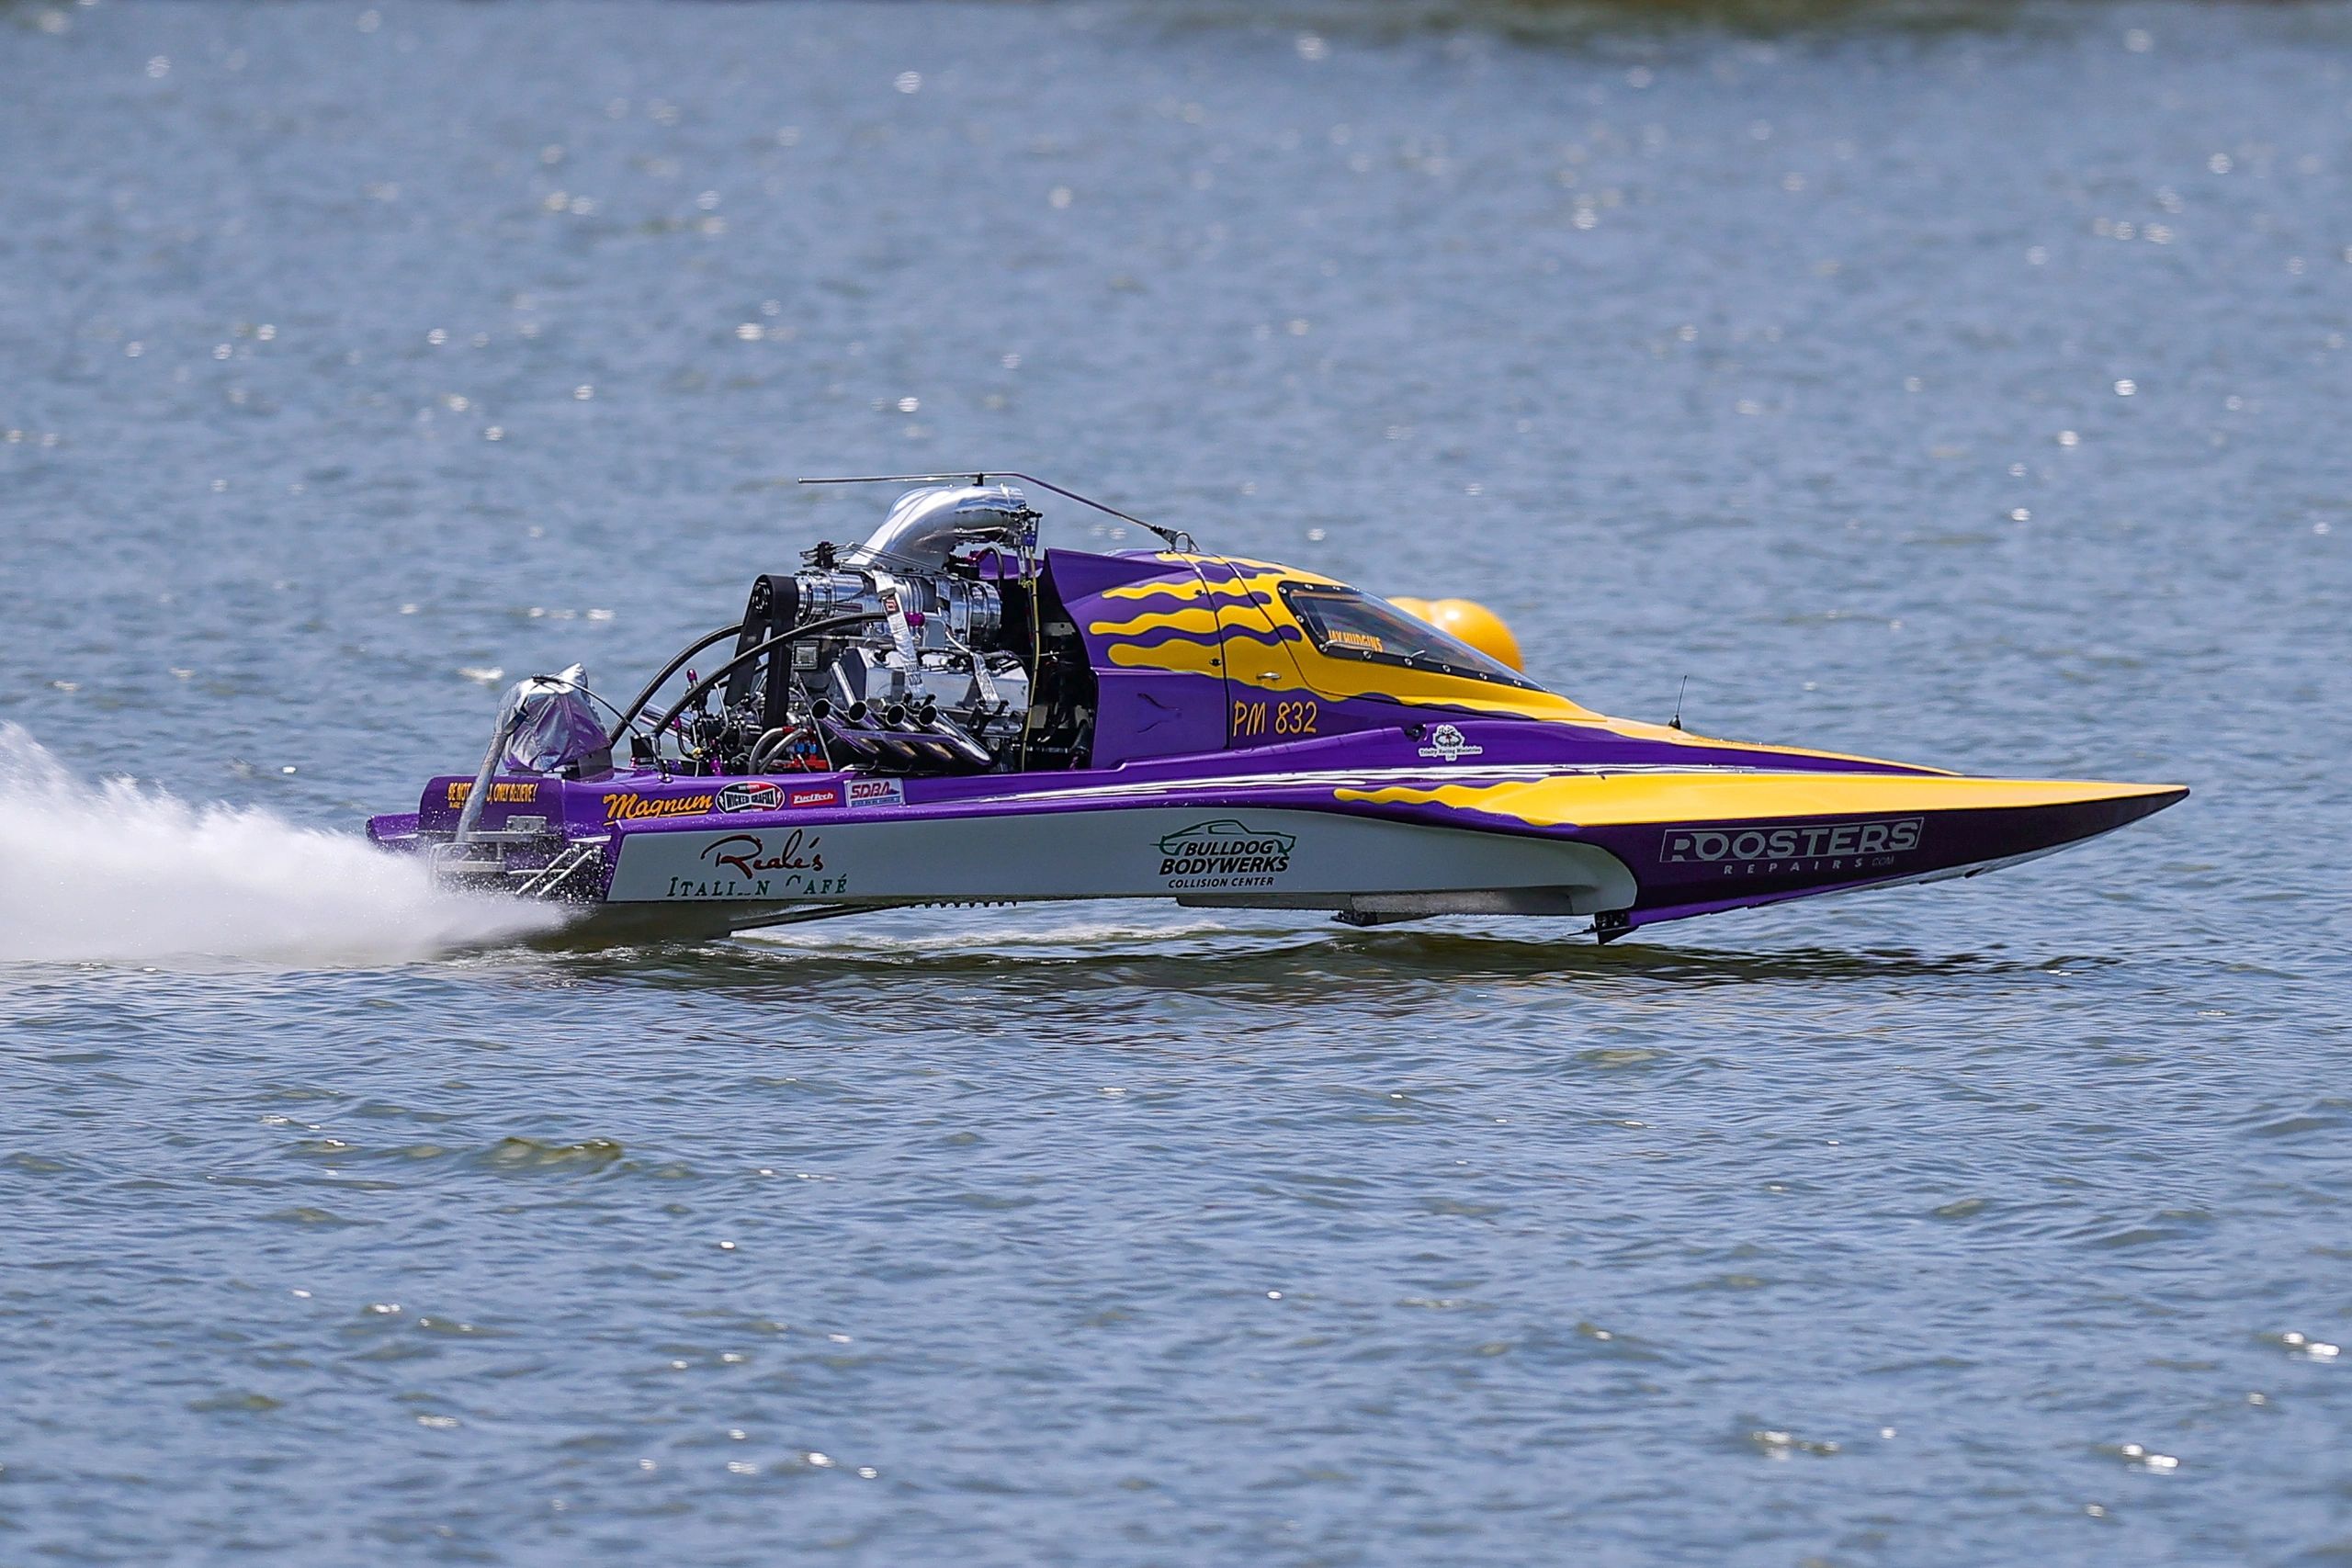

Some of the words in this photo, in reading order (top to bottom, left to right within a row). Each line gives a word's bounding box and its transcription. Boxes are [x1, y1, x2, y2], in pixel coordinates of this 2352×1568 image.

[1233, 700, 1267, 737] PM
[1275, 701, 1318, 734] 832
[793, 792, 834, 805] FuelTech
[850, 781, 891, 800] SDBA
[603, 793, 714, 820] Magnum
[1184, 840, 1275, 857] BULLDOG
[1672, 822, 1917, 862] ROOSTERS
[1159, 856, 1290, 875] BODYWERKS
[1724, 857, 1862, 874] REPAIRS
[667, 876, 771, 897] ITALIN
[1168, 879, 1227, 889] COLLISION
[1231, 876, 1274, 887] CENTER
